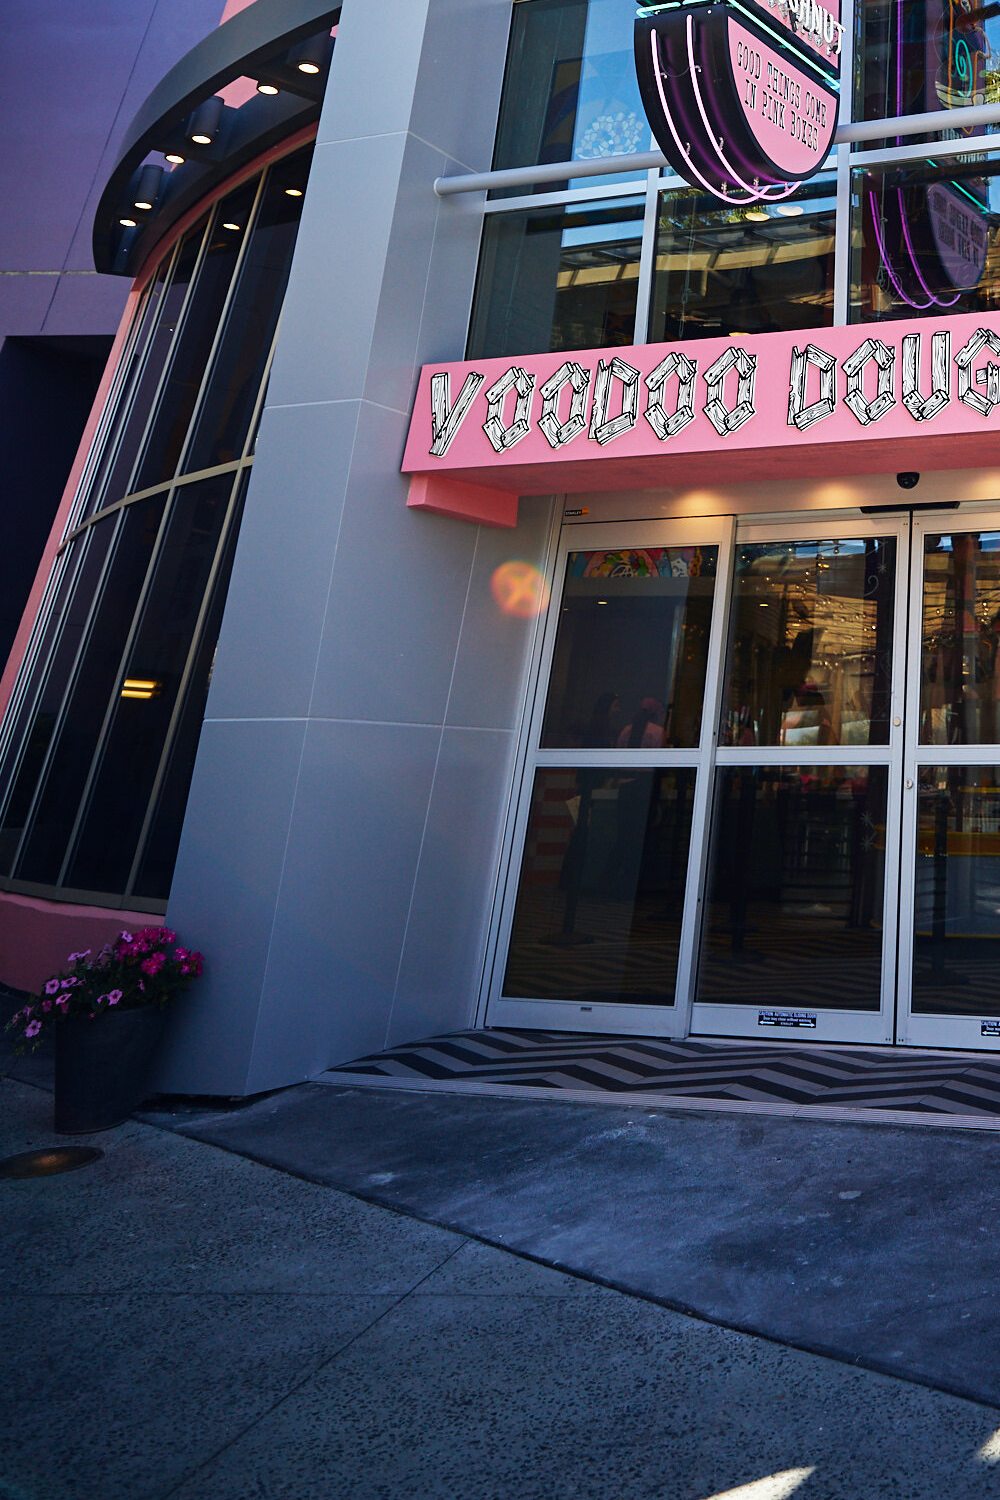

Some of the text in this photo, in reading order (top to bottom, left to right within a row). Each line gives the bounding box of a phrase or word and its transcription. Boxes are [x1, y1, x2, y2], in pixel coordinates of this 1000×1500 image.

[737, 41, 827, 128] GOOD THINGS COME
[745, 78, 819, 152] IN PINK BOXES
[428, 345, 758, 459] VOODOO
